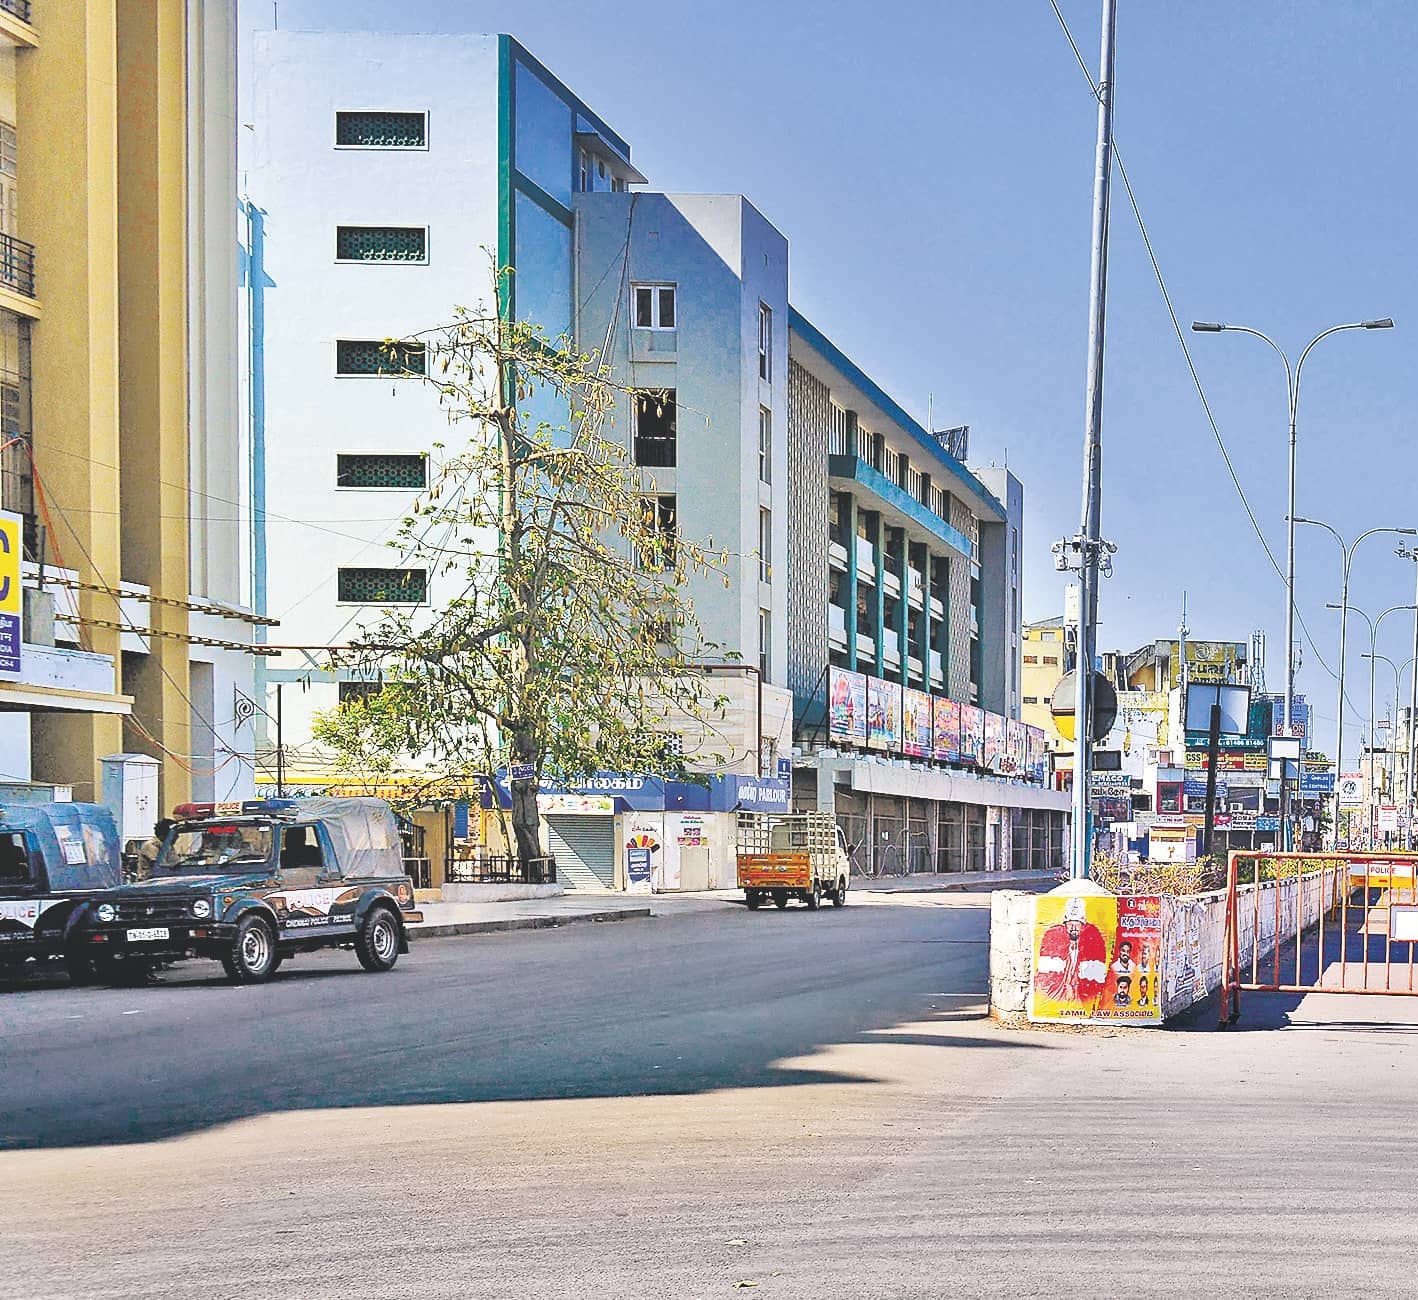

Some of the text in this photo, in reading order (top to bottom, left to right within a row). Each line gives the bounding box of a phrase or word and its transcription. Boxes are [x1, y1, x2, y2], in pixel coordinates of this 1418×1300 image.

[1186, 753, 1201, 761] CSS
[758, 787, 787, 803] PARLOUR
[216, 802, 241, 811] POLICE
